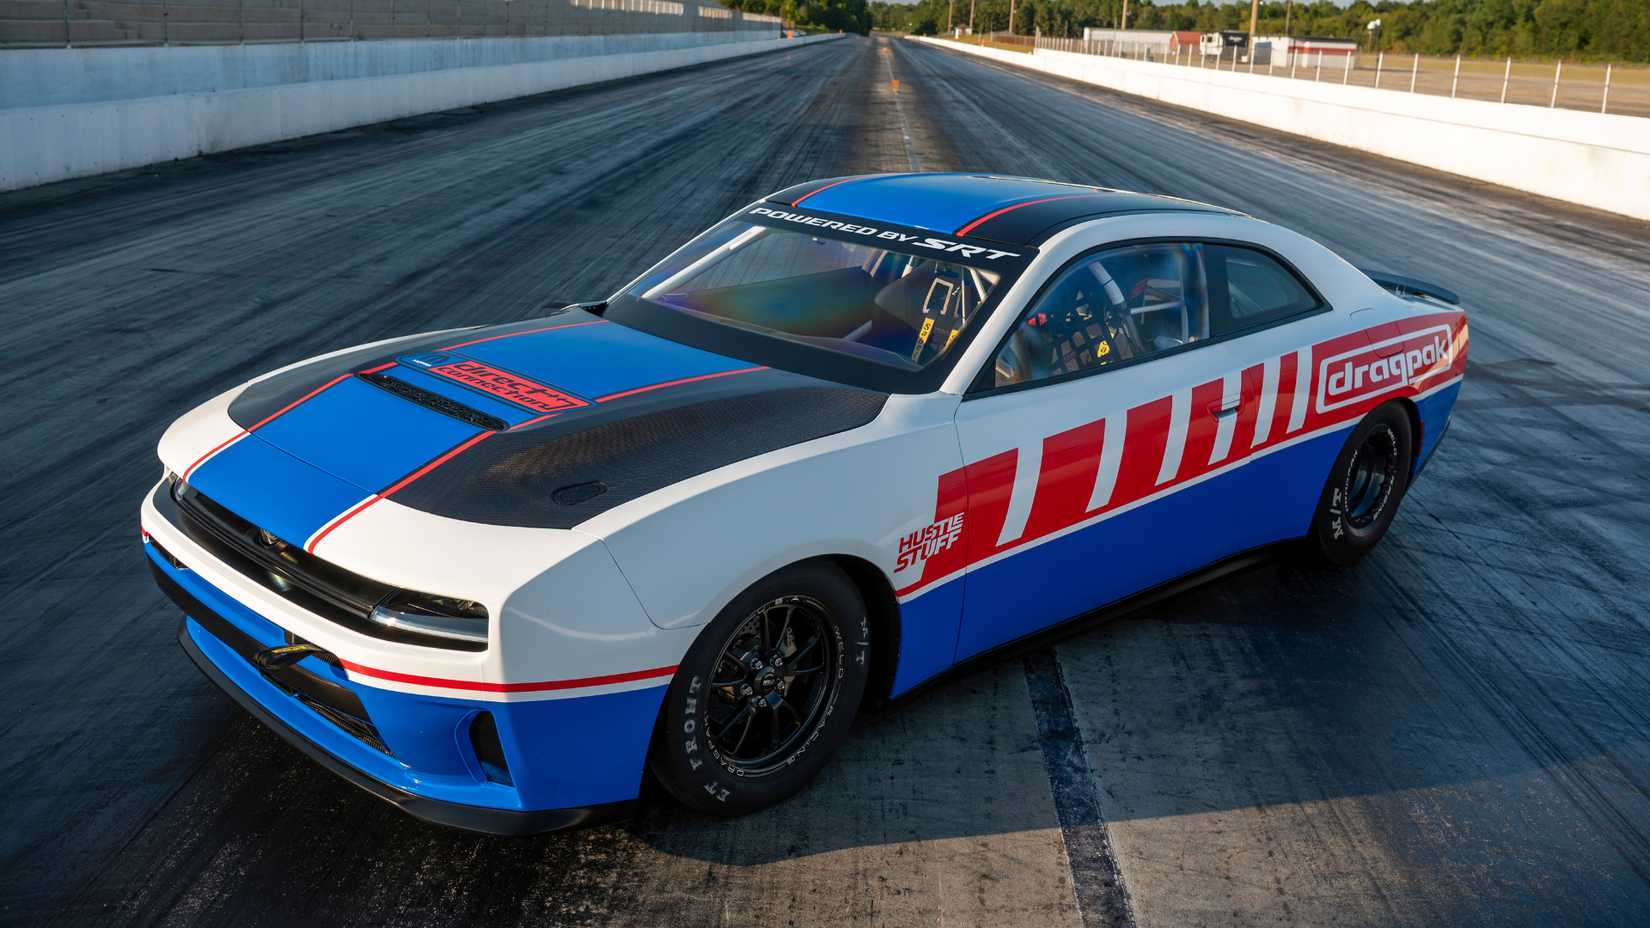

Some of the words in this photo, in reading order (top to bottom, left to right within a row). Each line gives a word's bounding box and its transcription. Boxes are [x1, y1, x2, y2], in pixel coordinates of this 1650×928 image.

[750, 207, 880, 235] POWERED
[876, 231, 919, 243] BY
[912, 237, 1020, 260] SRT
[454, 363, 559, 398] direct
[1328, 335, 1448, 396] dragpak
[439, 367, 549, 410] connection
[893, 528, 962, 574] STUFF
[898, 512, 965, 554] HUSTLE
